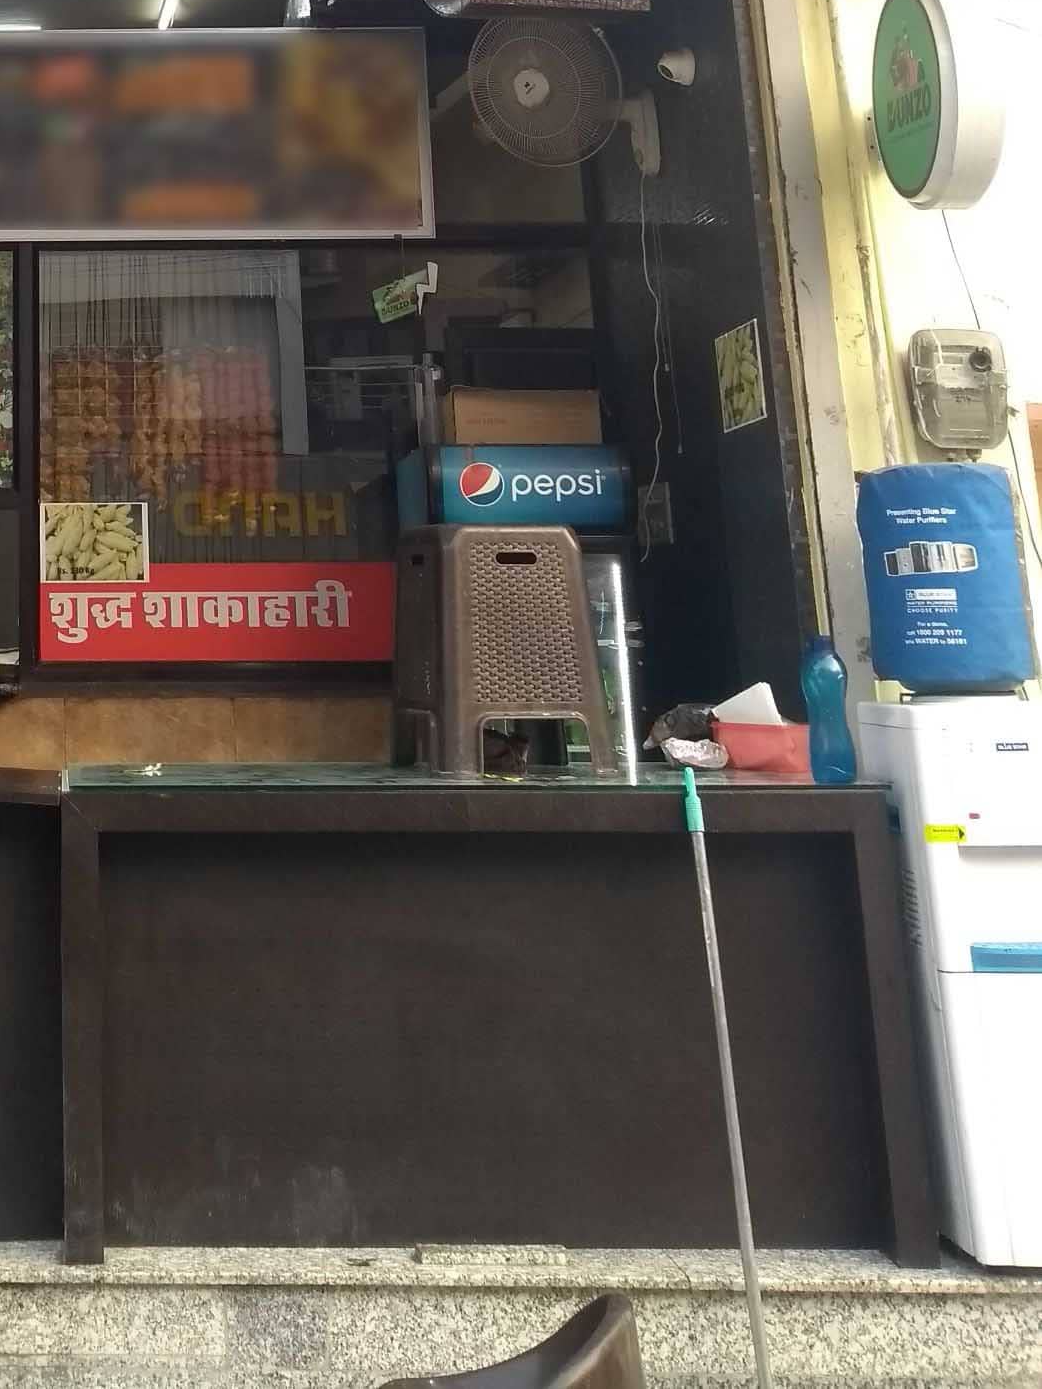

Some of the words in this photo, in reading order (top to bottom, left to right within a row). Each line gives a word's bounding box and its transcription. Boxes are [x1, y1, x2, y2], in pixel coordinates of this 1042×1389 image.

[511, 468, 603, 502] pepsi
[48, 591, 136, 644] शुद्ध
[142, 580, 352, 628] शाकाहारी
